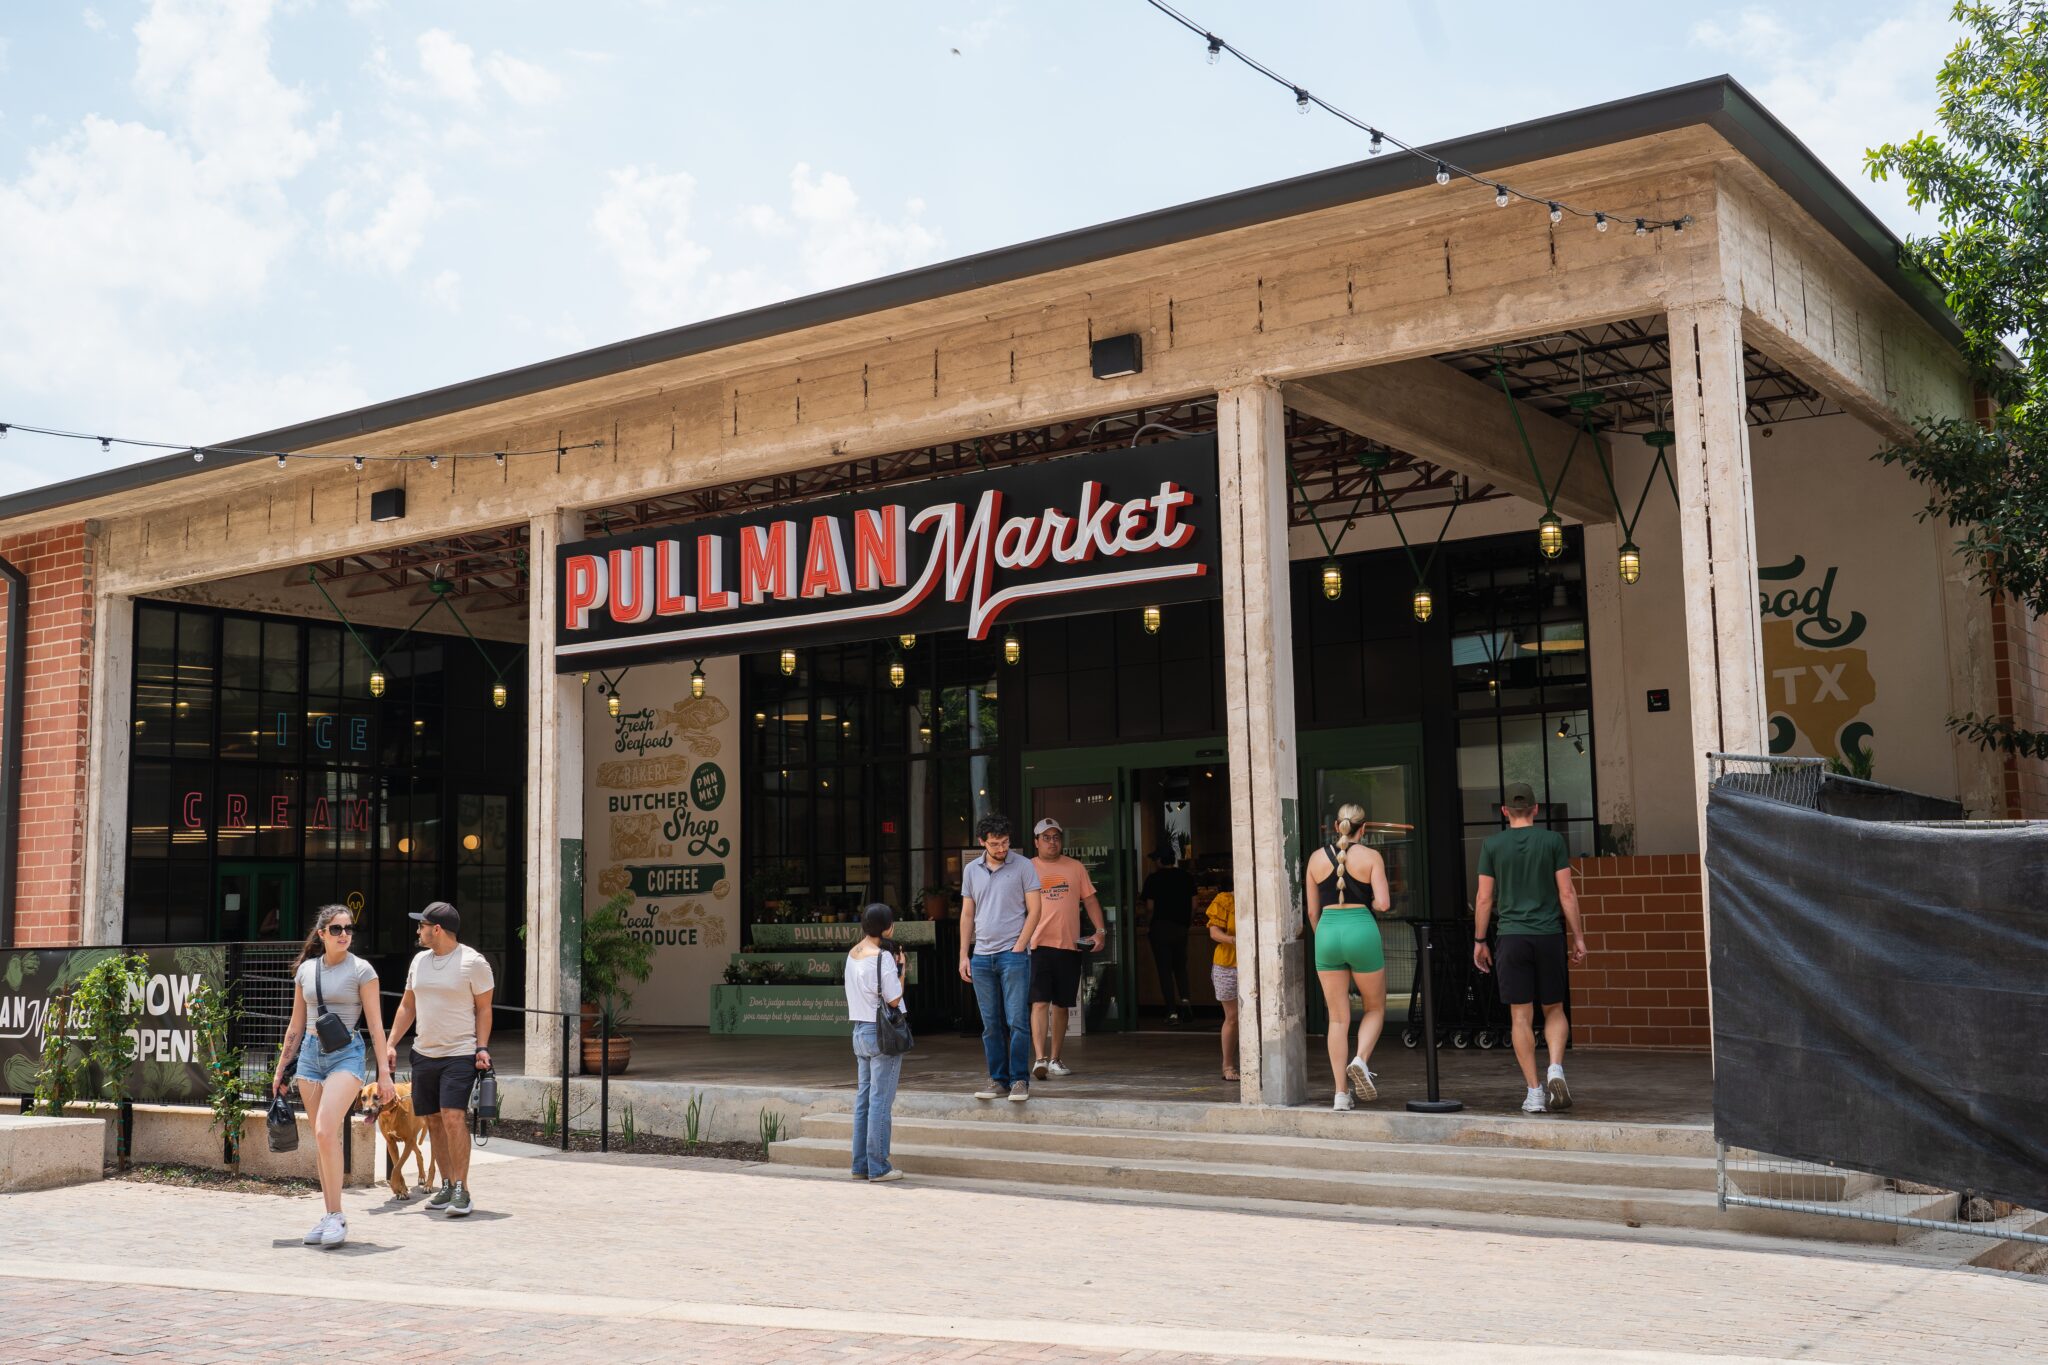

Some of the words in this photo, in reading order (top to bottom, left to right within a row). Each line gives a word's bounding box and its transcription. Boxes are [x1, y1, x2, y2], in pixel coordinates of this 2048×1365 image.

[565, 504, 906, 630] PULLMAN
[908, 480, 1200, 640] Market
[277, 712, 367, 750] ICE
[615, 707, 655, 735] Fresh
[614, 730, 673, 757] Seafood
[624, 763, 670, 781] BAKERY
[696, 771, 718, 790] PMN
[609, 791, 689, 813] BUTCHER
[698, 784, 719, 802] MKT
[183, 791, 369, 832] CREAM
[663, 806, 731, 858] Shop
[1063, 846, 1108, 857] PULLMAN
[647, 868, 699, 892] COFFEE
[794, 926, 850, 940] PULLMAN
[807, 958, 831, 974] Pots
[121, 974, 202, 1016] NOW
[766, 997, 785, 1009] judge
[802, 998, 814, 1009] day
[815, 998, 823, 1009] by
[823, 998, 834, 1007] the
[771, 1011, 783, 1021] but
[783, 1011, 792, 1023] by
[792, 1011, 802, 1021] the
[821, 1012, 834, 1021] that
